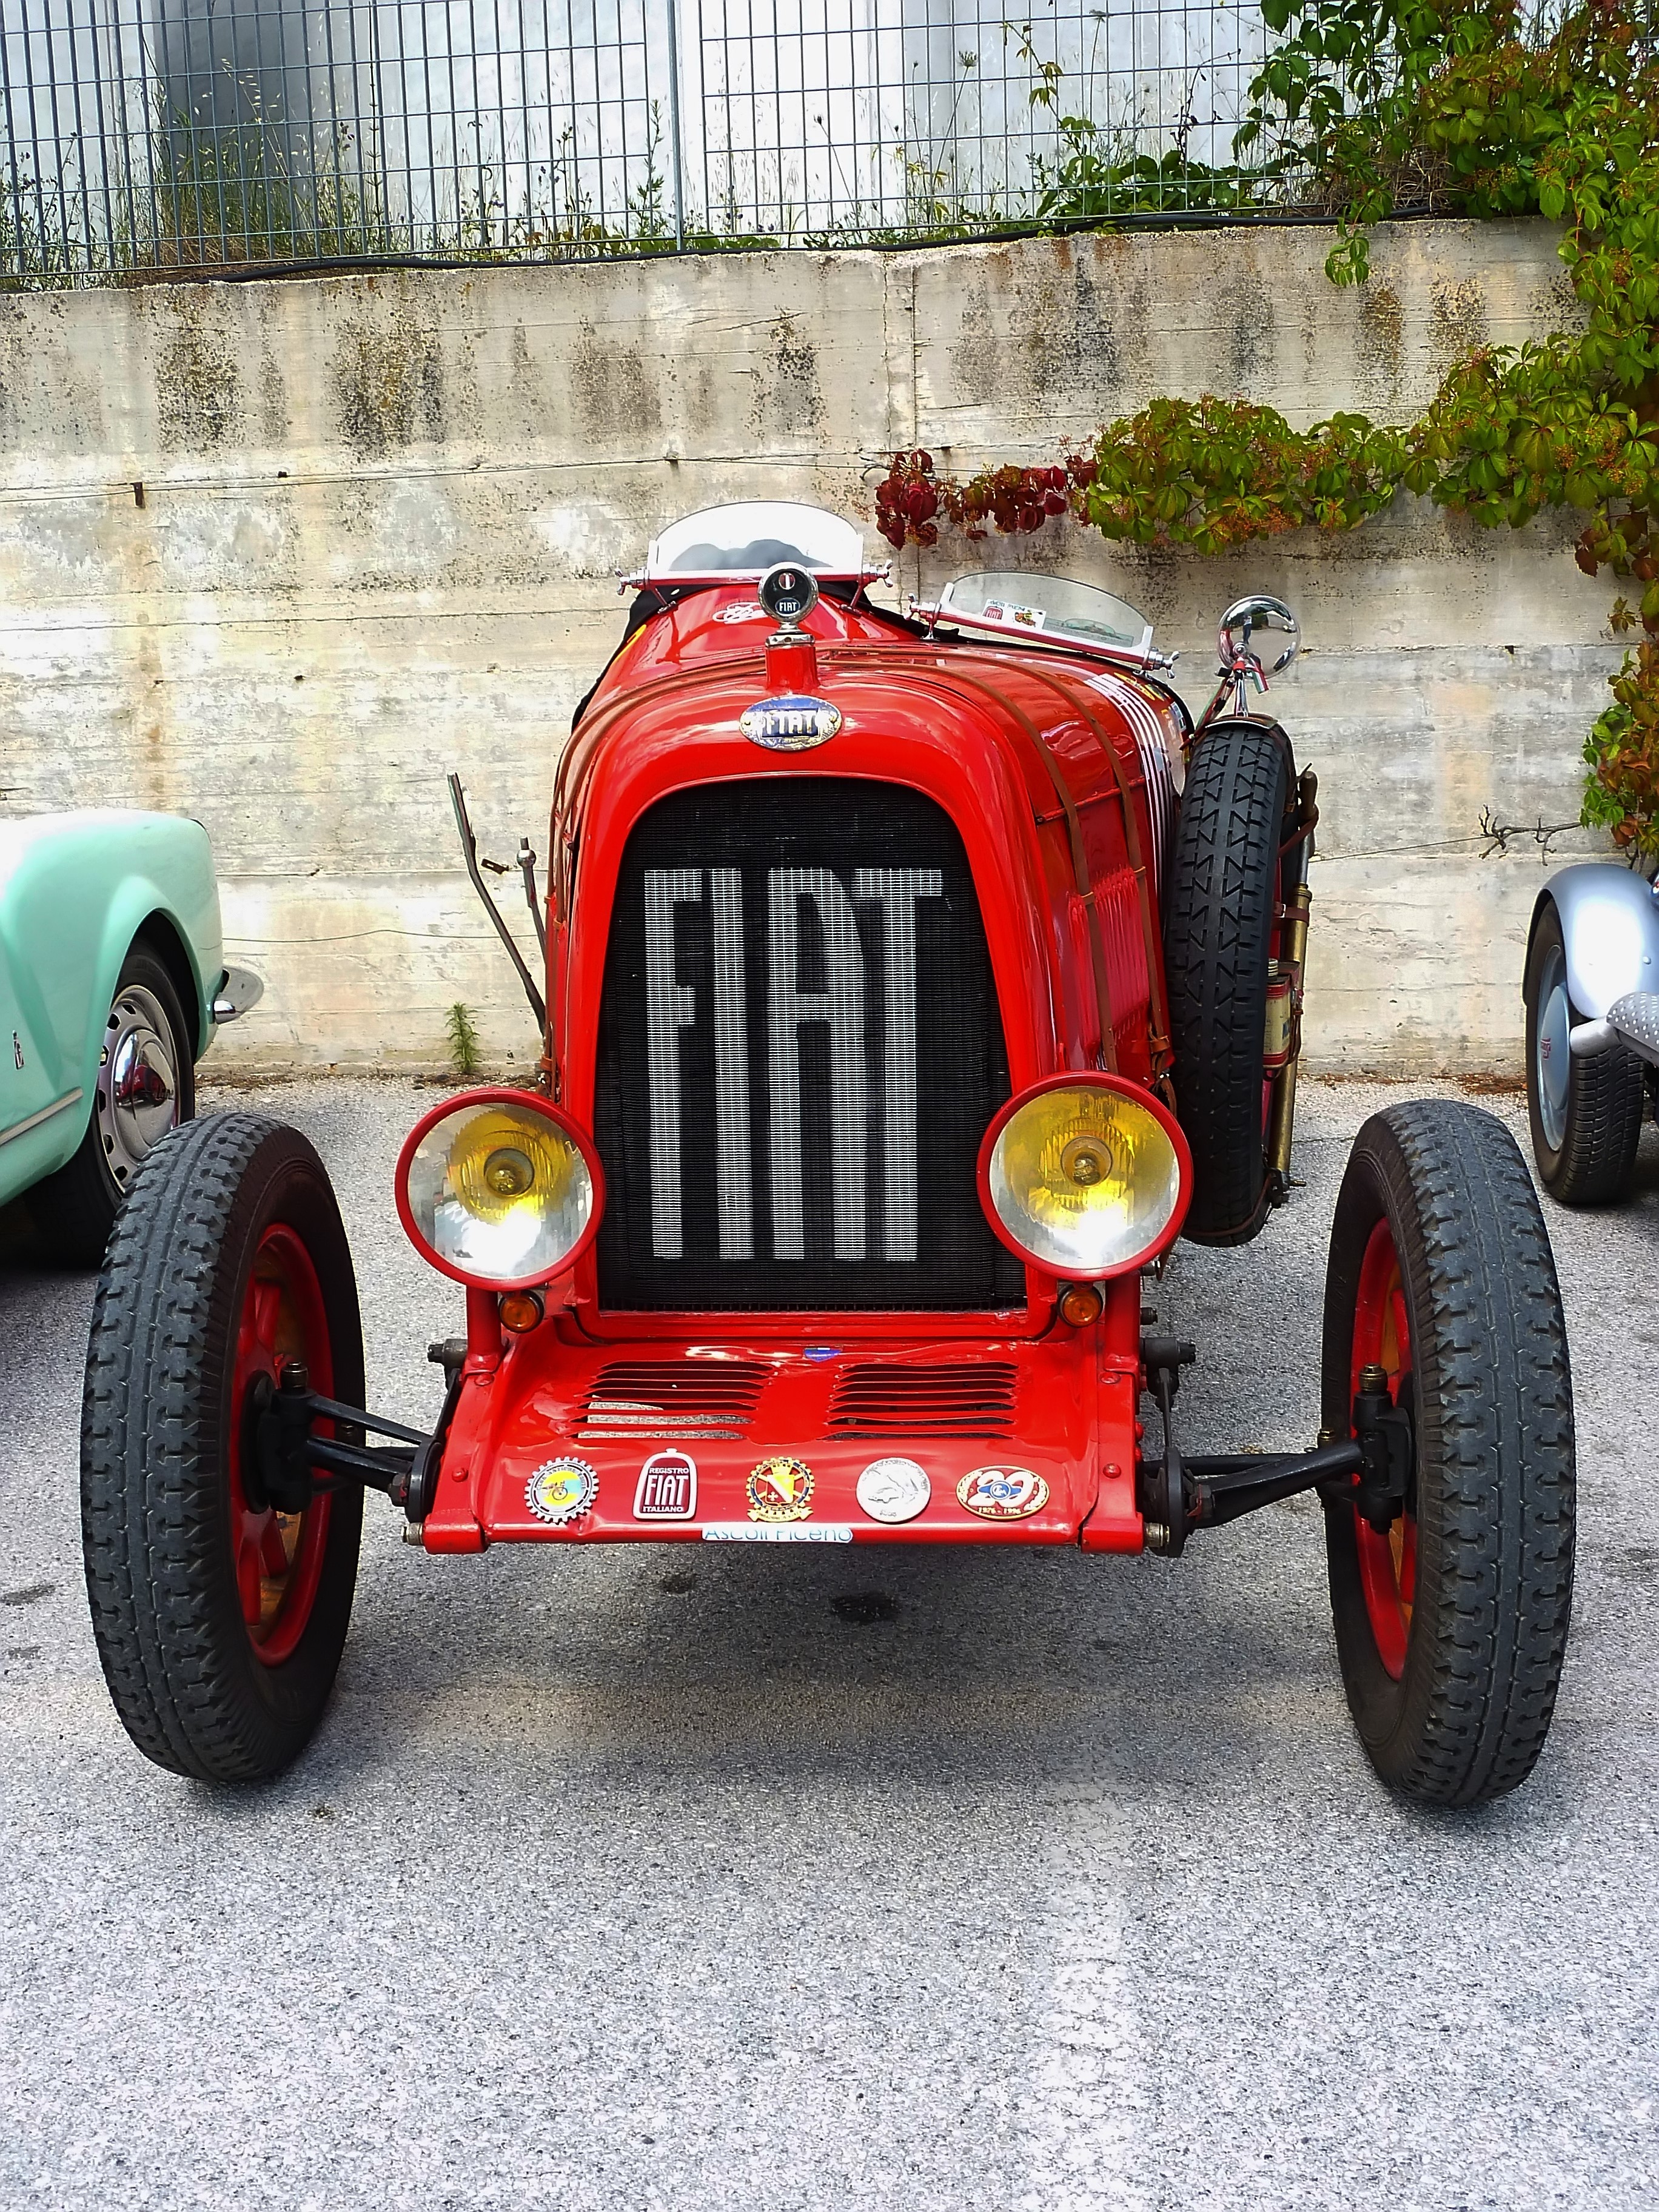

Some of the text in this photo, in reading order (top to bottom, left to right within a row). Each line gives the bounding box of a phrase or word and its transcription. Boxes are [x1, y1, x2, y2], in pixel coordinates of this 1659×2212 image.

[779, 602, 797, 611] FIAT
[763, 710, 816, 734] FIAT
[644, 867, 943, 1262] FIAT
[645, 1475, 689, 1506] FIAT
[967, 1470, 1034, 1507] 20
